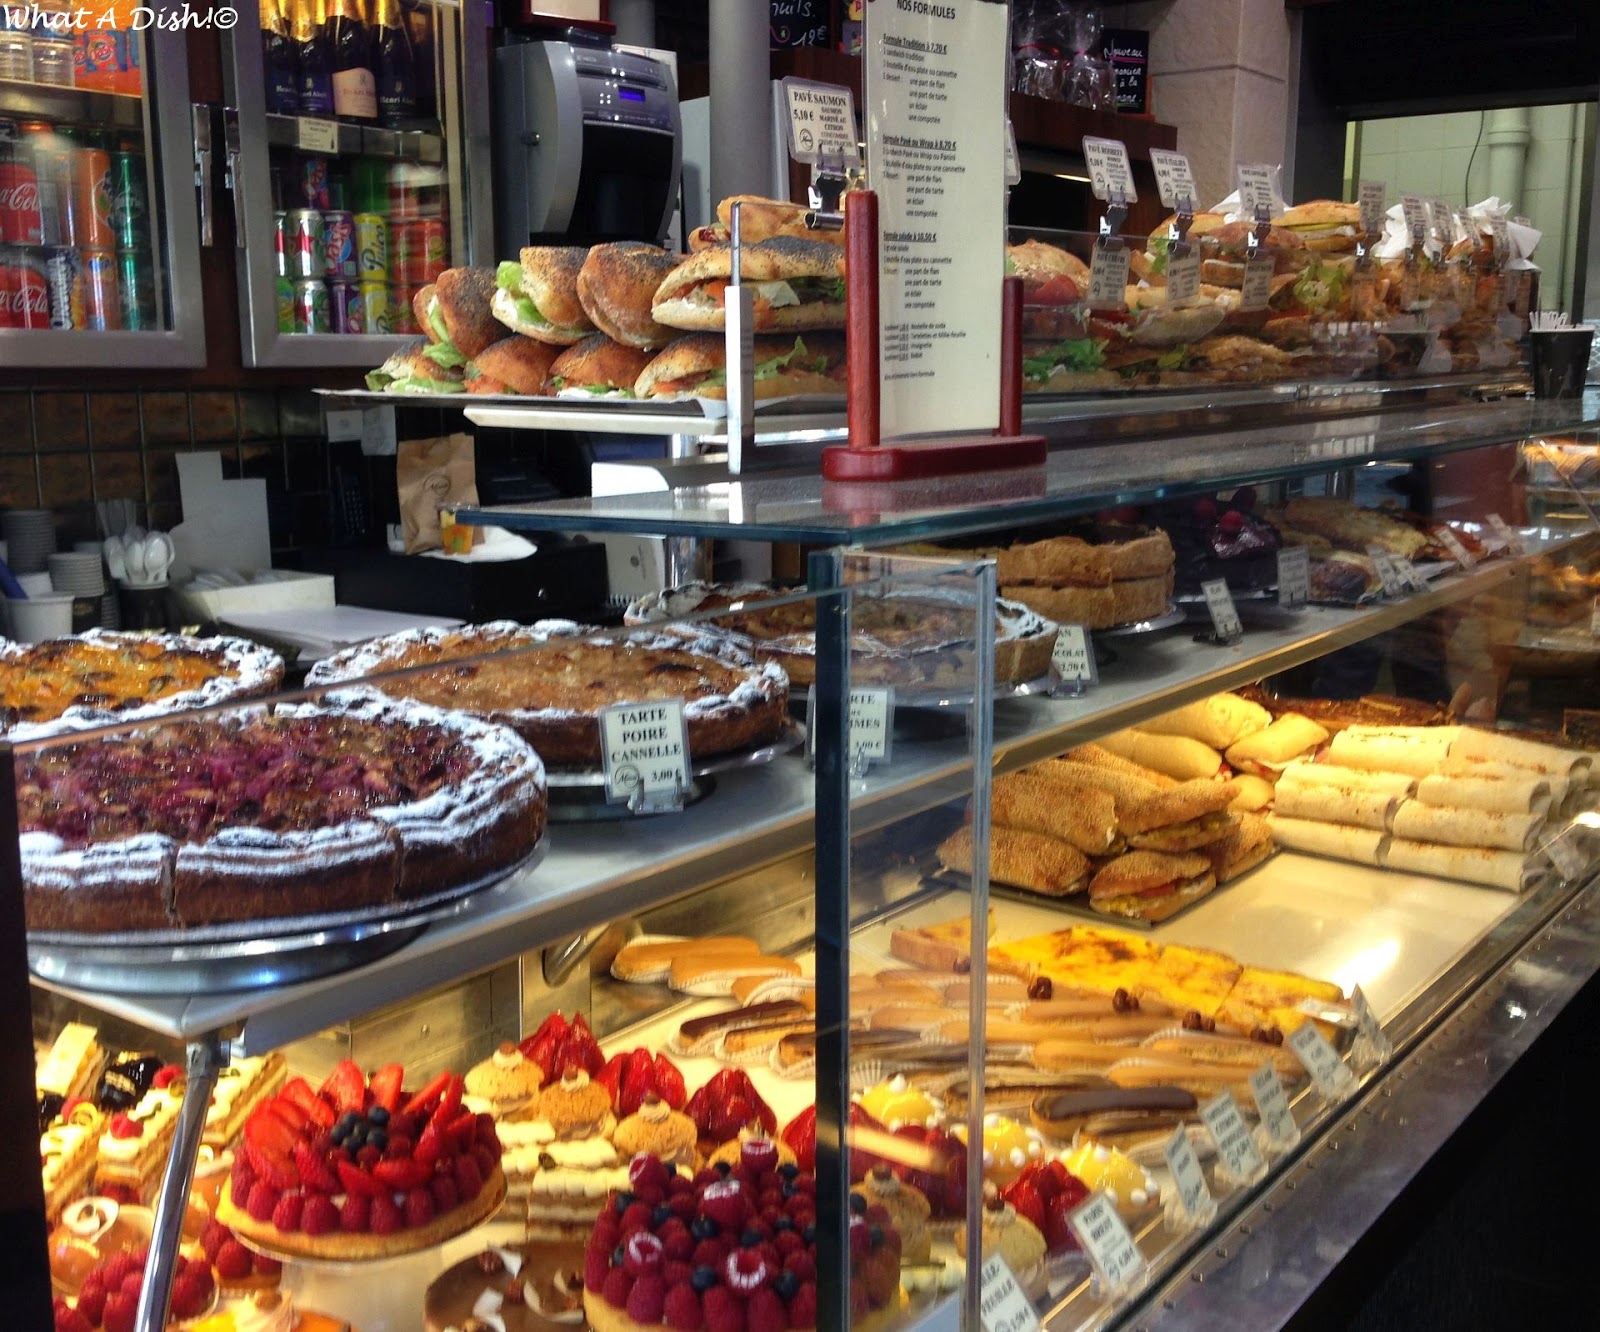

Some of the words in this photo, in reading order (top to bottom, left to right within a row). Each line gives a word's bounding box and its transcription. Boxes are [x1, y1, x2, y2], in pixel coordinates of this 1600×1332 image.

[897, 0, 912, 11] NOS
[913, 2, 956, 19] FORMULES
[883, 33, 902, 46] Formule
[903, 37, 926, 50] Tradition
[917, 67, 928, 75] plate
[936, 70, 958, 78] cannette
[936, 80, 946, 88] flan
[794, 90, 813, 103] PAVÉ
[814, 94, 847, 107] SAUMON
[935, 93, 948, 101] tarte
[793, 109, 809, 122] 5,10
[810, 110, 814, 122] €
[850, 694, 876, 704] RTE
[618, 706, 668, 726] TARTE
[622, 727, 668, 745] POIRE
[611, 742, 681, 764] CANNELLE
[652, 768, 673, 783] 3,00
